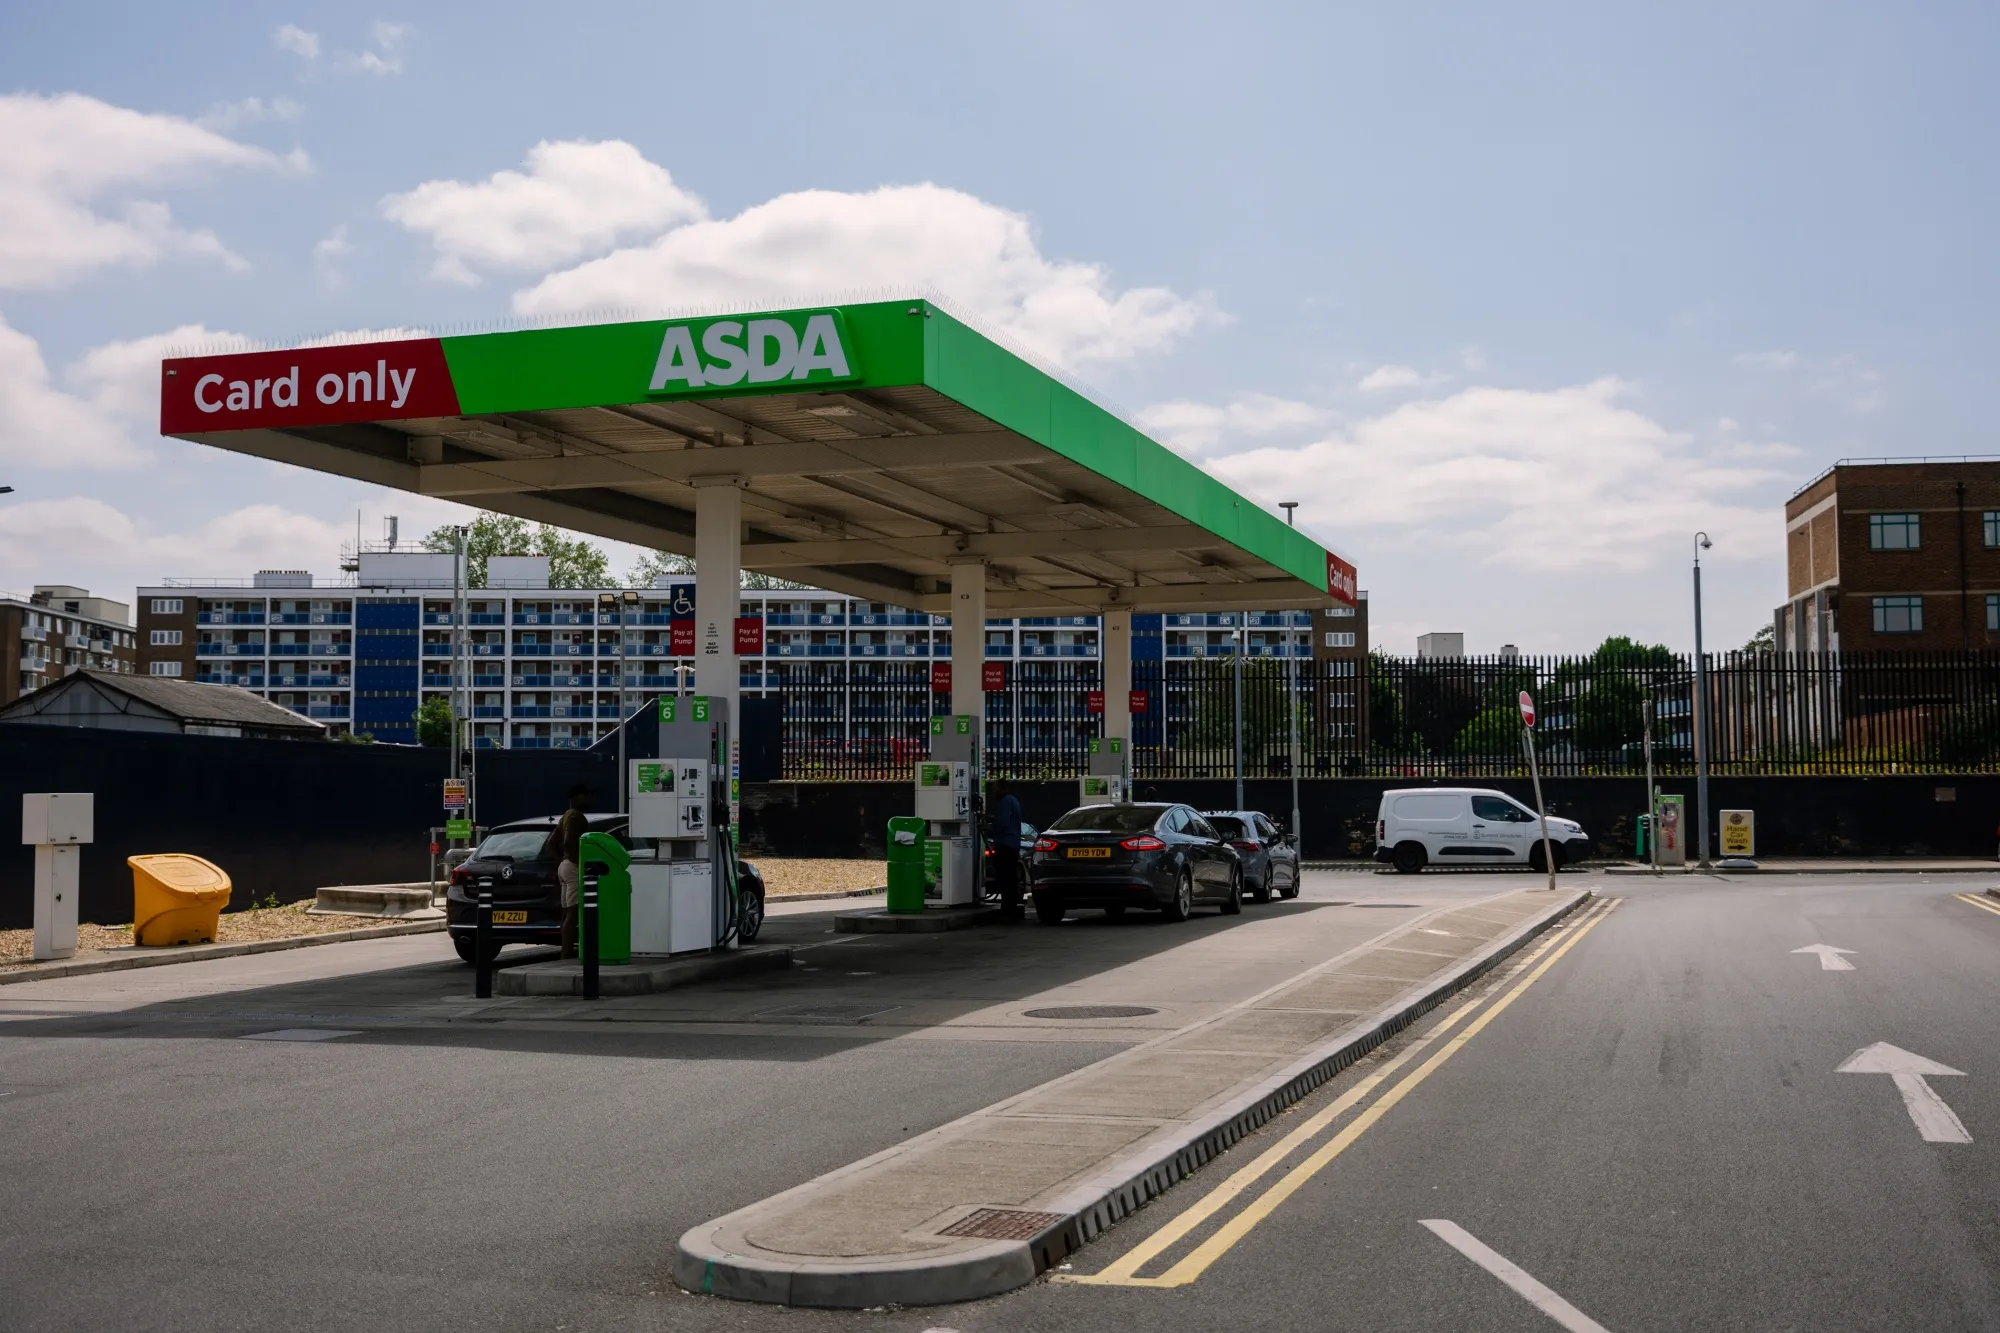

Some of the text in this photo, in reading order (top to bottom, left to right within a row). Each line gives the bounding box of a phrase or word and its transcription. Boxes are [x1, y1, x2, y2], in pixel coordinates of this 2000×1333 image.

[648, 314, 851, 391] ASDA
[194, 359, 417, 413] Card only
[1329, 563, 1353, 600] Card only
[662, 707, 672, 719] 6
[696, 706, 705, 718] 5
[933, 723, 941, 732] 4
[960, 722, 967, 732] 3
[1091, 744, 1098, 752] 2
[1113, 743, 1118, 752] 1
[1072, 848, 1090, 857] DY19
[492, 911, 524, 922] Y14 ZZU
